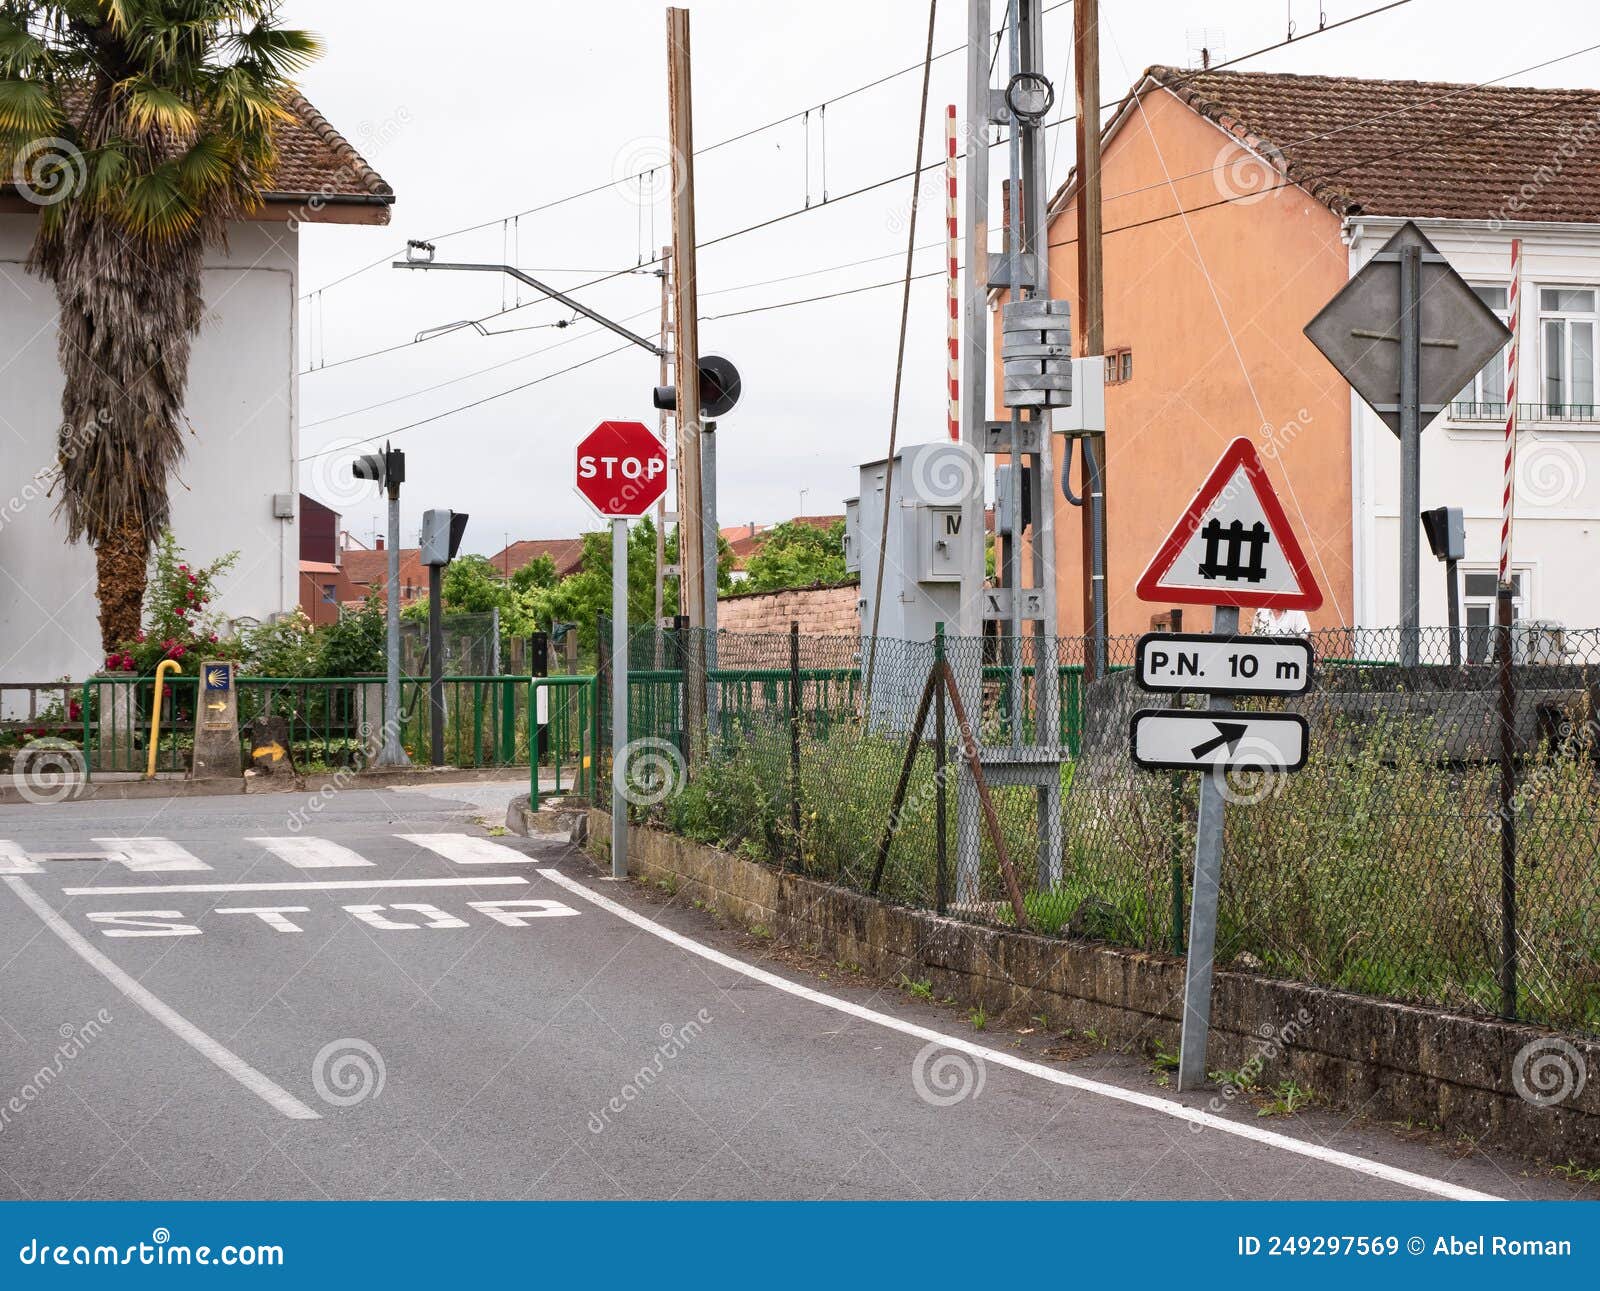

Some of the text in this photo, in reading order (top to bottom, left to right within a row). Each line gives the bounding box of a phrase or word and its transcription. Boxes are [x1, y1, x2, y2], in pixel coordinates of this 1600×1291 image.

[579, 455, 665, 479] STOP
[1150, 651, 1301, 680] P.N. 10 m
[85, 899, 581, 938] STOP
